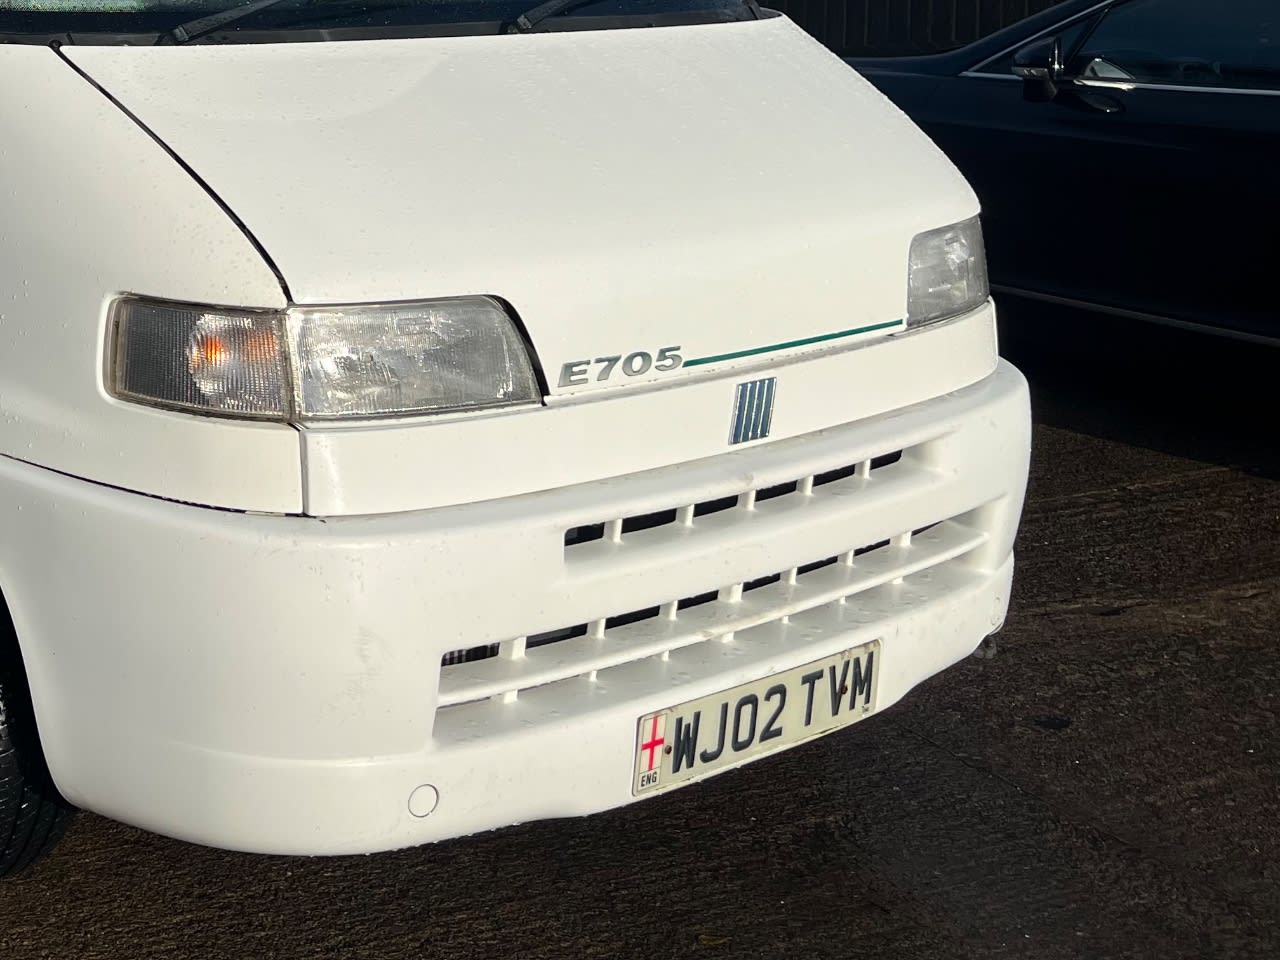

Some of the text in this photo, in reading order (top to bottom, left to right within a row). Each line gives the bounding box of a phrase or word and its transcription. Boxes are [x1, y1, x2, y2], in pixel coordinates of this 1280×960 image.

[557, 344, 683, 388] E705
[672, 651, 874, 774] WJ02 TVM
[640, 771, 658, 787] ENG
